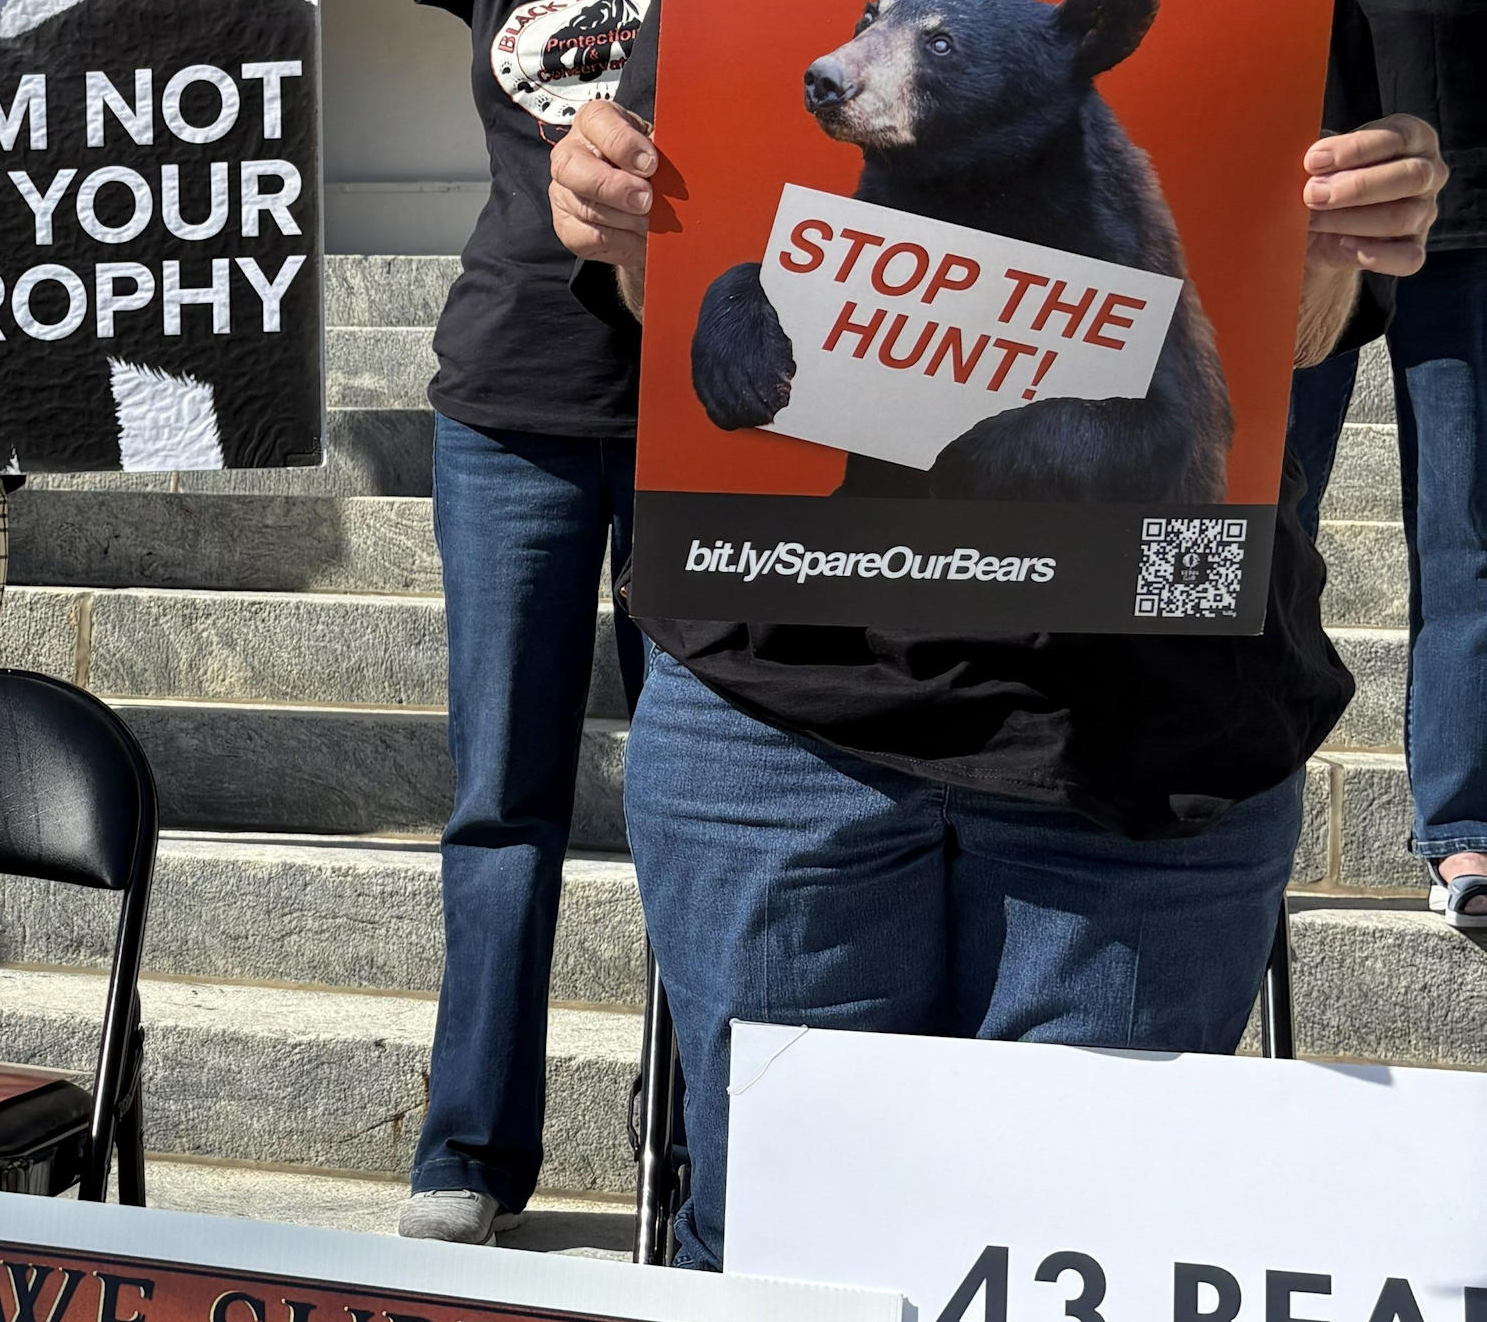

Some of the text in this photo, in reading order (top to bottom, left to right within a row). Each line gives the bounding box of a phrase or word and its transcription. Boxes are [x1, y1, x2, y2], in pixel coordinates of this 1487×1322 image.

[498, 1, 568, 54] BLACK
[589, 48, 598, 60] &
[83, 60, 303, 148] NOT
[536, 57, 627, 84] Conservat
[7, 158, 303, 246] YOUR
[776, 219, 1148, 351] STOP THE
[820, 300, 1059, 403] HUNT!
[685, 539, 1057, 584] bit.ly/SpareOurBears
